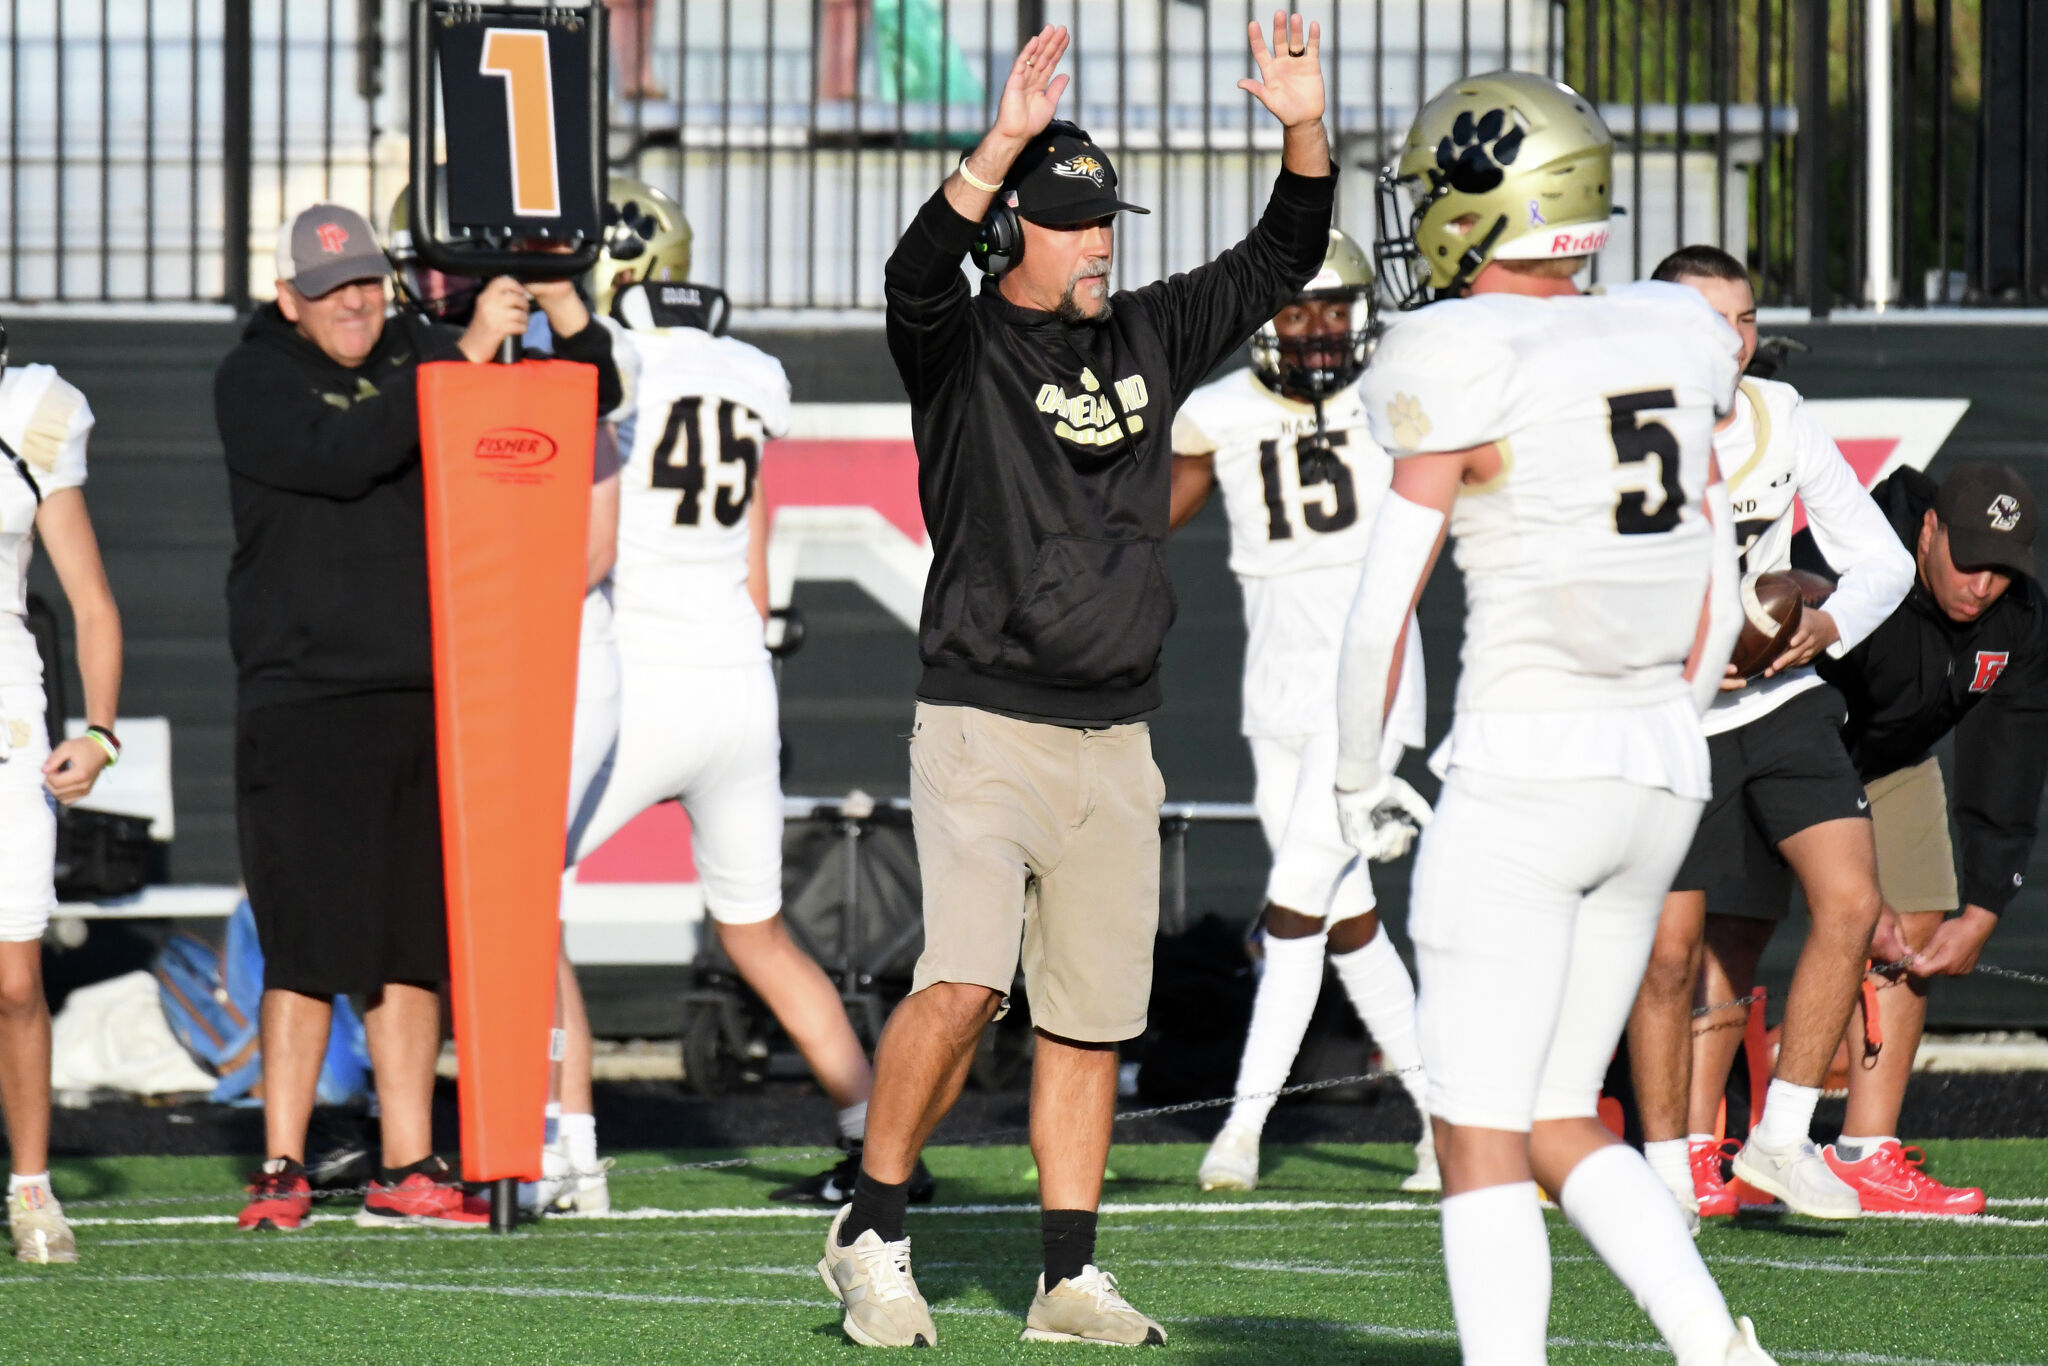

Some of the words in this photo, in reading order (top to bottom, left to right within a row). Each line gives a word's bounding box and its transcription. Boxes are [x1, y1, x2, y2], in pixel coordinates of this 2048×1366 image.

[479, 27, 562, 218] 1
[1036, 384, 1098, 428] DAIEL
[1280, 418, 1331, 435] HAN
[475, 437, 541, 458] FISHER
[649, 395, 772, 528] 45
[1259, 429, 1358, 541] 15
[1606, 386, 1688, 535] 5
[1732, 499, 1757, 515] ND
